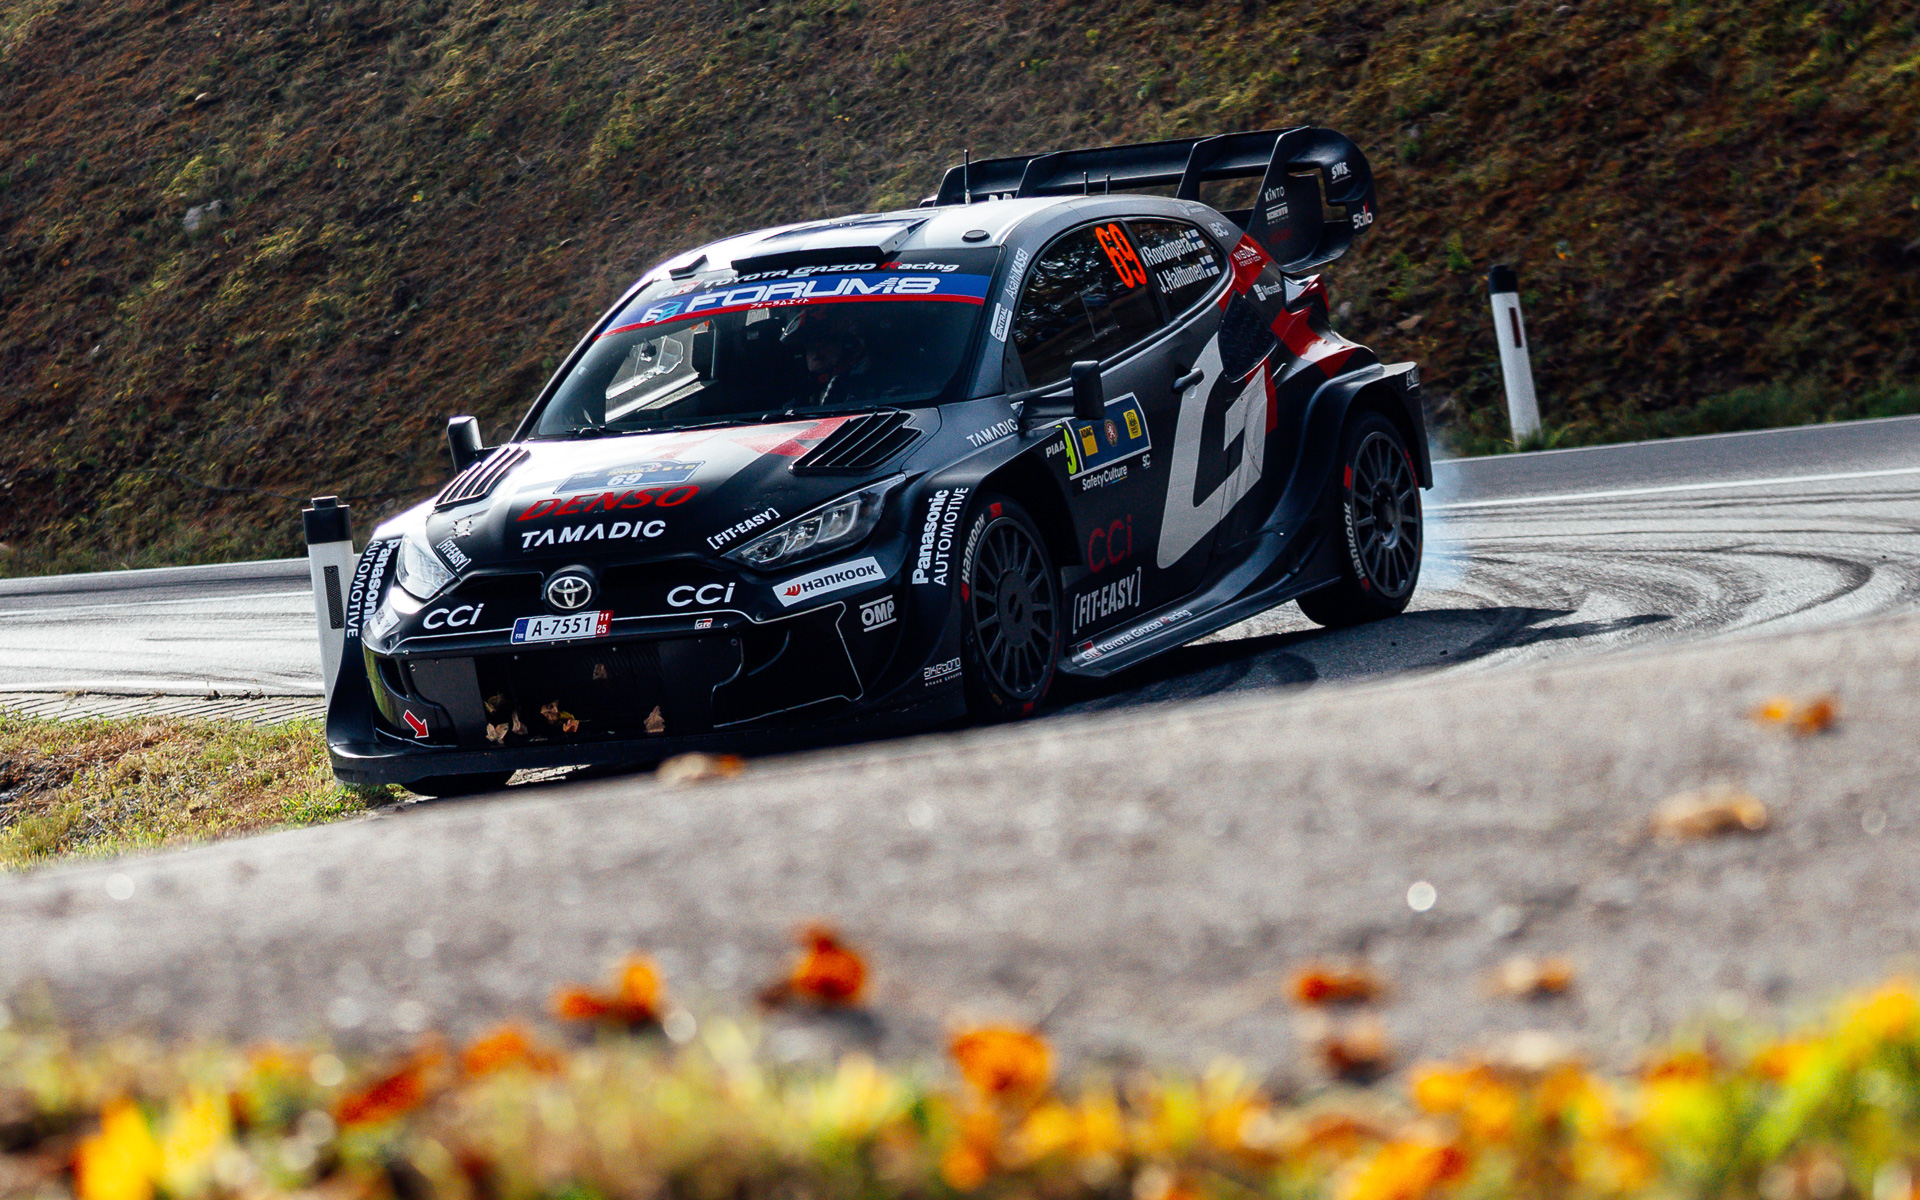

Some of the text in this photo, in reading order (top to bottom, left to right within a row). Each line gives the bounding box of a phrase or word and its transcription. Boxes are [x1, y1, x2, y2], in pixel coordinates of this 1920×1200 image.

[1095, 223, 1147, 288] 69
[704, 269, 788, 288] TOYOTA
[786, 263, 876, 279] GAZOO
[880, 261, 960, 273] Racing
[685, 277, 940, 313] FORUM8
[966, 418, 1019, 448] TAMADIC
[1045, 440, 1065, 458] PIAA
[1142, 453, 1151, 467] SC
[606, 472, 644, 486] 69
[517, 485, 700, 522] DENSO
[521, 520, 666, 549] TAMADIC
[912, 489, 949, 585] Panasonic
[934, 487, 969, 586] AUTOMOTIVE
[346, 540, 383, 638] AUTOMOTIVE
[531, 616, 591, 637] A-7551
[600, 613, 609, 621] 11
[861, 600, 895, 626] OMP
[597, 625, 607, 634] 25
[1097, 634, 1134, 652] TOYOTA
[1131, 620, 1163, 638] GAZOO
[1161, 608, 1192, 624] Racing
